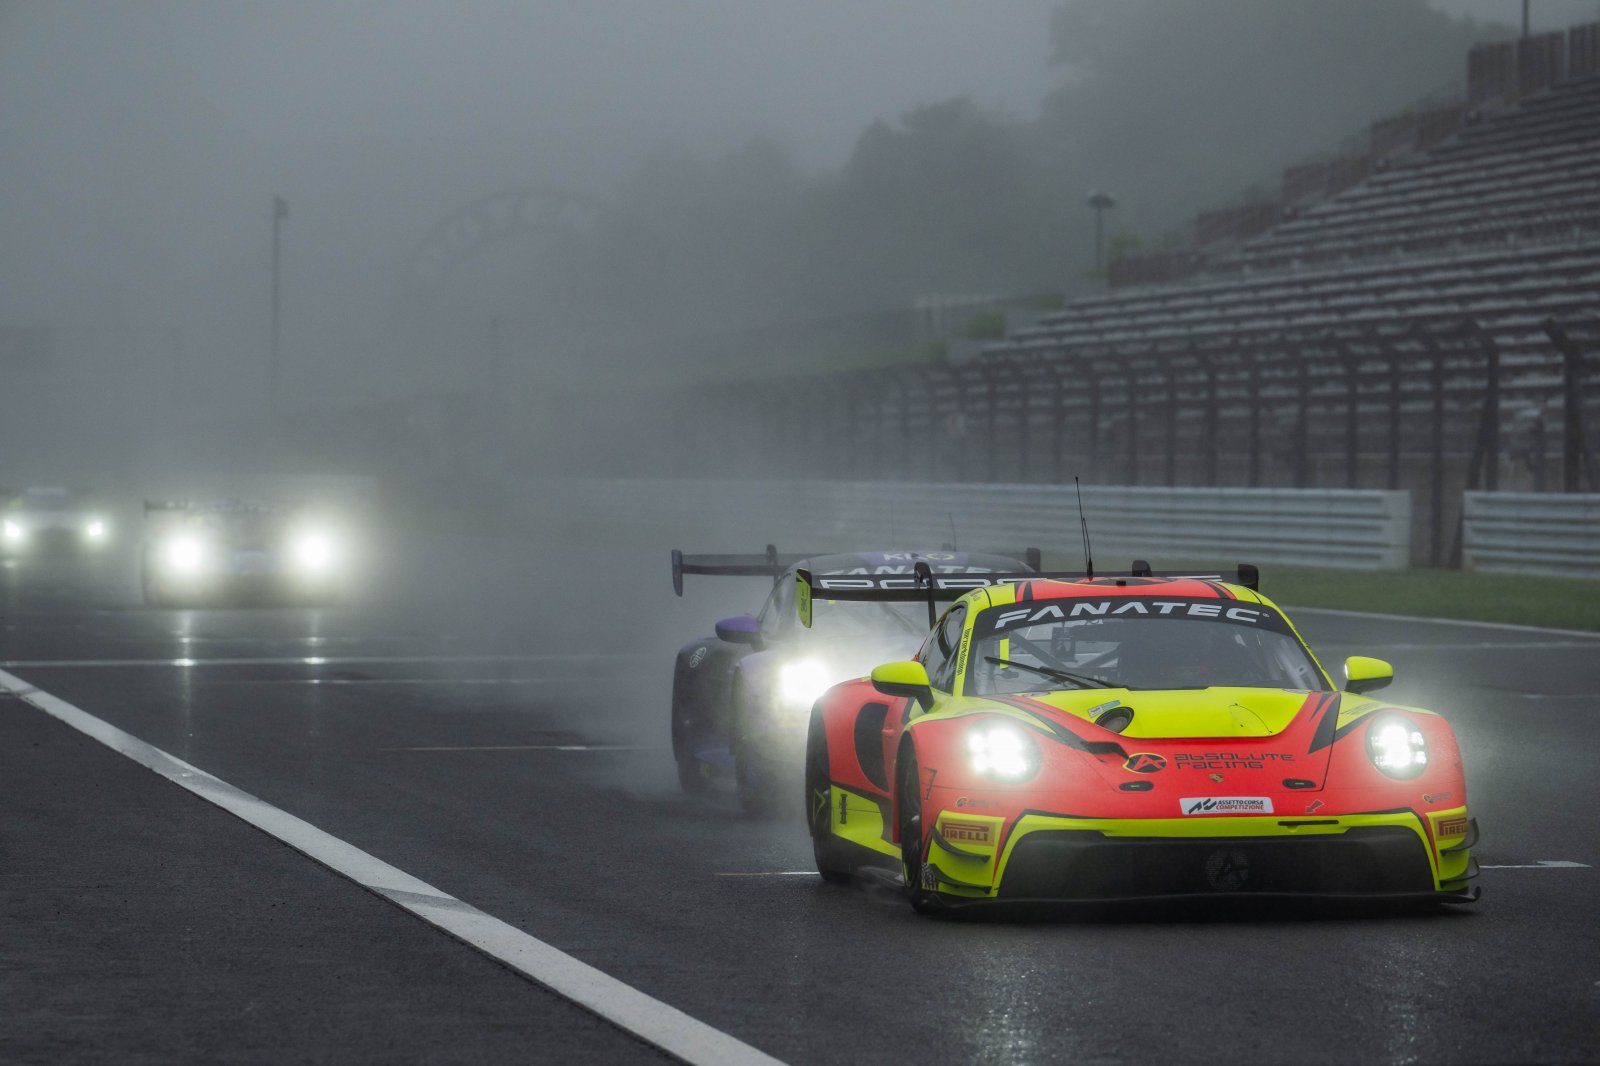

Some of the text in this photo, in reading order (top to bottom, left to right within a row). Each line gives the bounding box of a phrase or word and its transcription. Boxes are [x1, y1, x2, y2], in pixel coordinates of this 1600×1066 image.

[995, 601, 1261, 629] FANATEC
[941, 821, 990, 842] PIRELLI
[1438, 817, 1468, 836] PIREL
